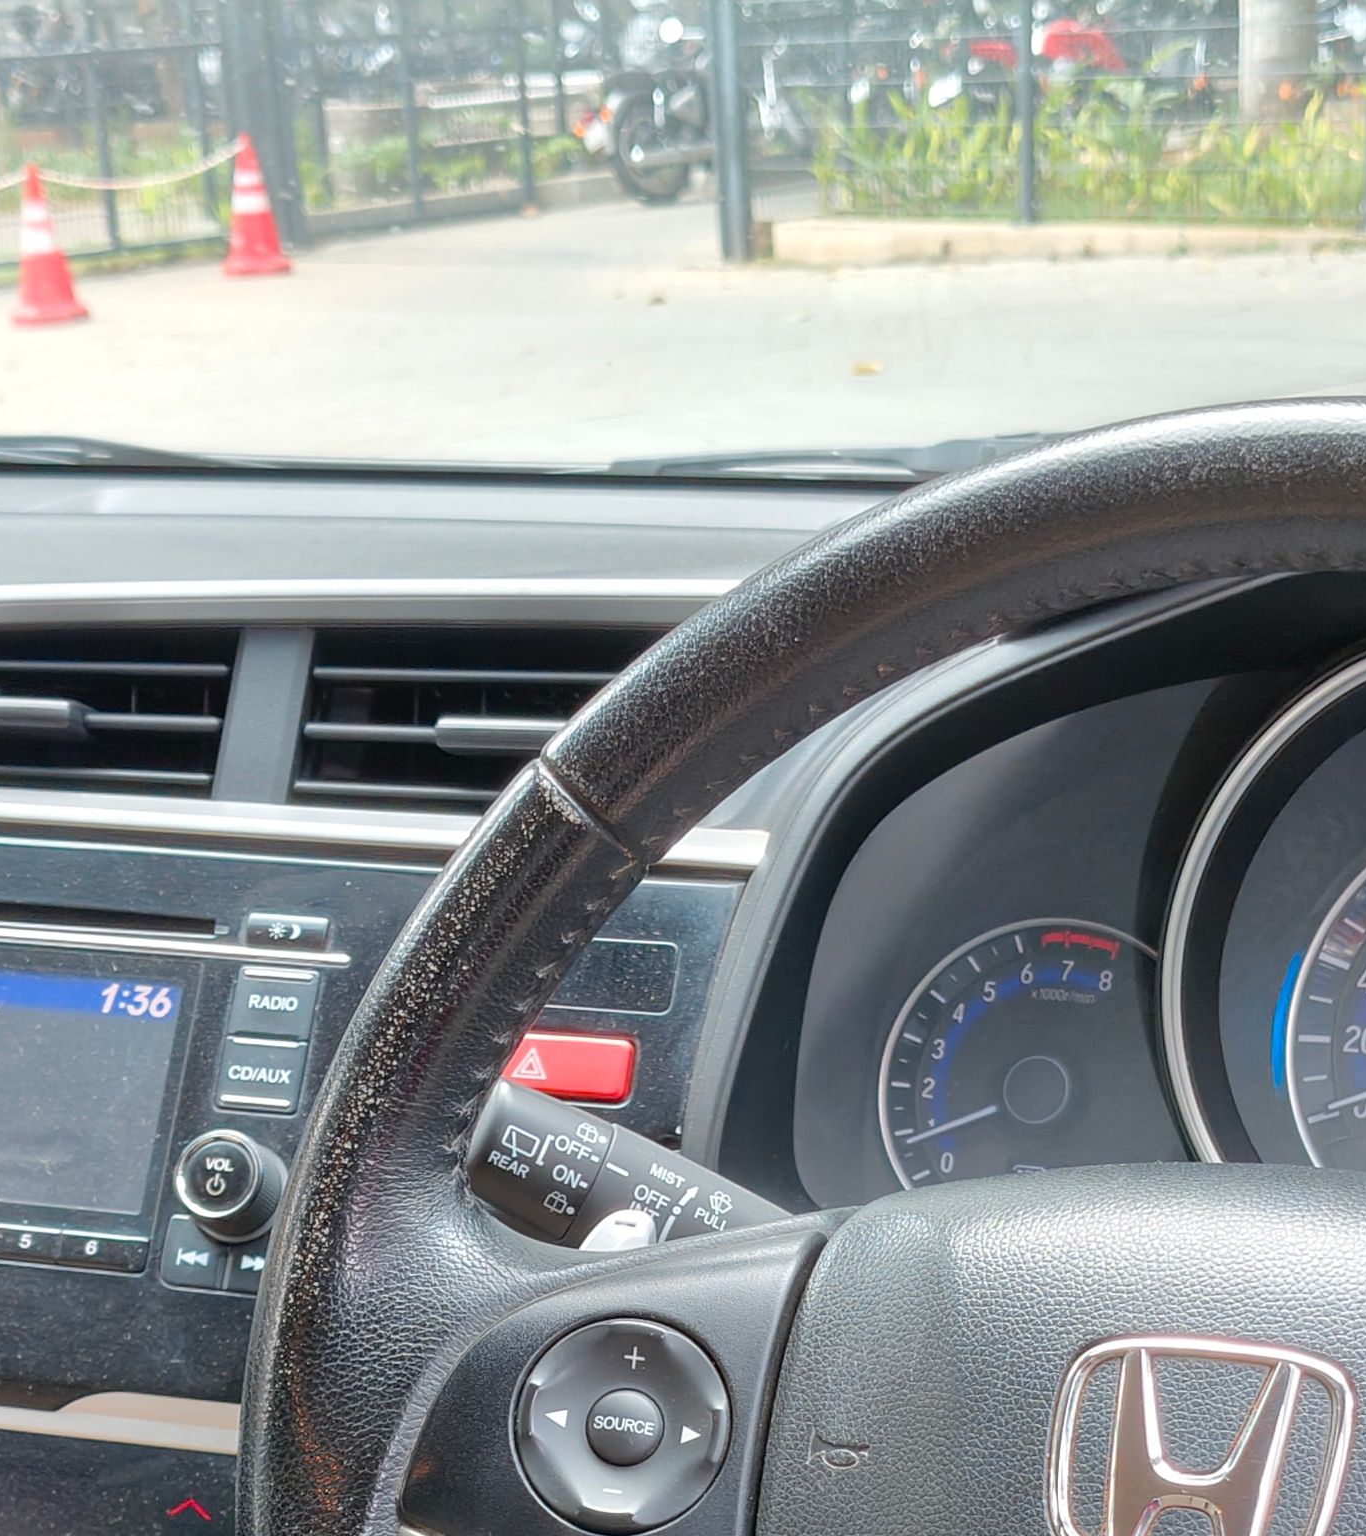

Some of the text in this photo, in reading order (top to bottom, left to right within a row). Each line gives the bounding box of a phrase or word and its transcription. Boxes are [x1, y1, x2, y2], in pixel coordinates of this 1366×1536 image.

[1020, 962, 1033, 985] 6
[1062, 960, 1075, 981] 7
[1099, 970, 1113, 991] 8
[100, 982, 173, 1018] 1:36
[983, 981, 996, 1002] 5
[248, 994, 298, 1011] RADIO
[952, 1003, 965, 1024] 4
[931, 1039, 945, 1060] 3
[228, 1065, 291, 1084] CD/AUX
[921, 1078, 935, 1099] 2
[554, 1135, 591, 1162] OFF
[205, 1157, 234, 1172] VOL
[487, 1151, 530, 1179] REAR
[940, 1151, 954, 1174] 0
[552, 1165, 581, 1189] ON
[649, 1163, 686, 1189] MIST
[634, 1184, 671, 1210] OFF
[18, 1233, 32, 1249] 5
[85, 1240, 98, 1255] 6
[593, 1414, 656, 1438] SOURCE
